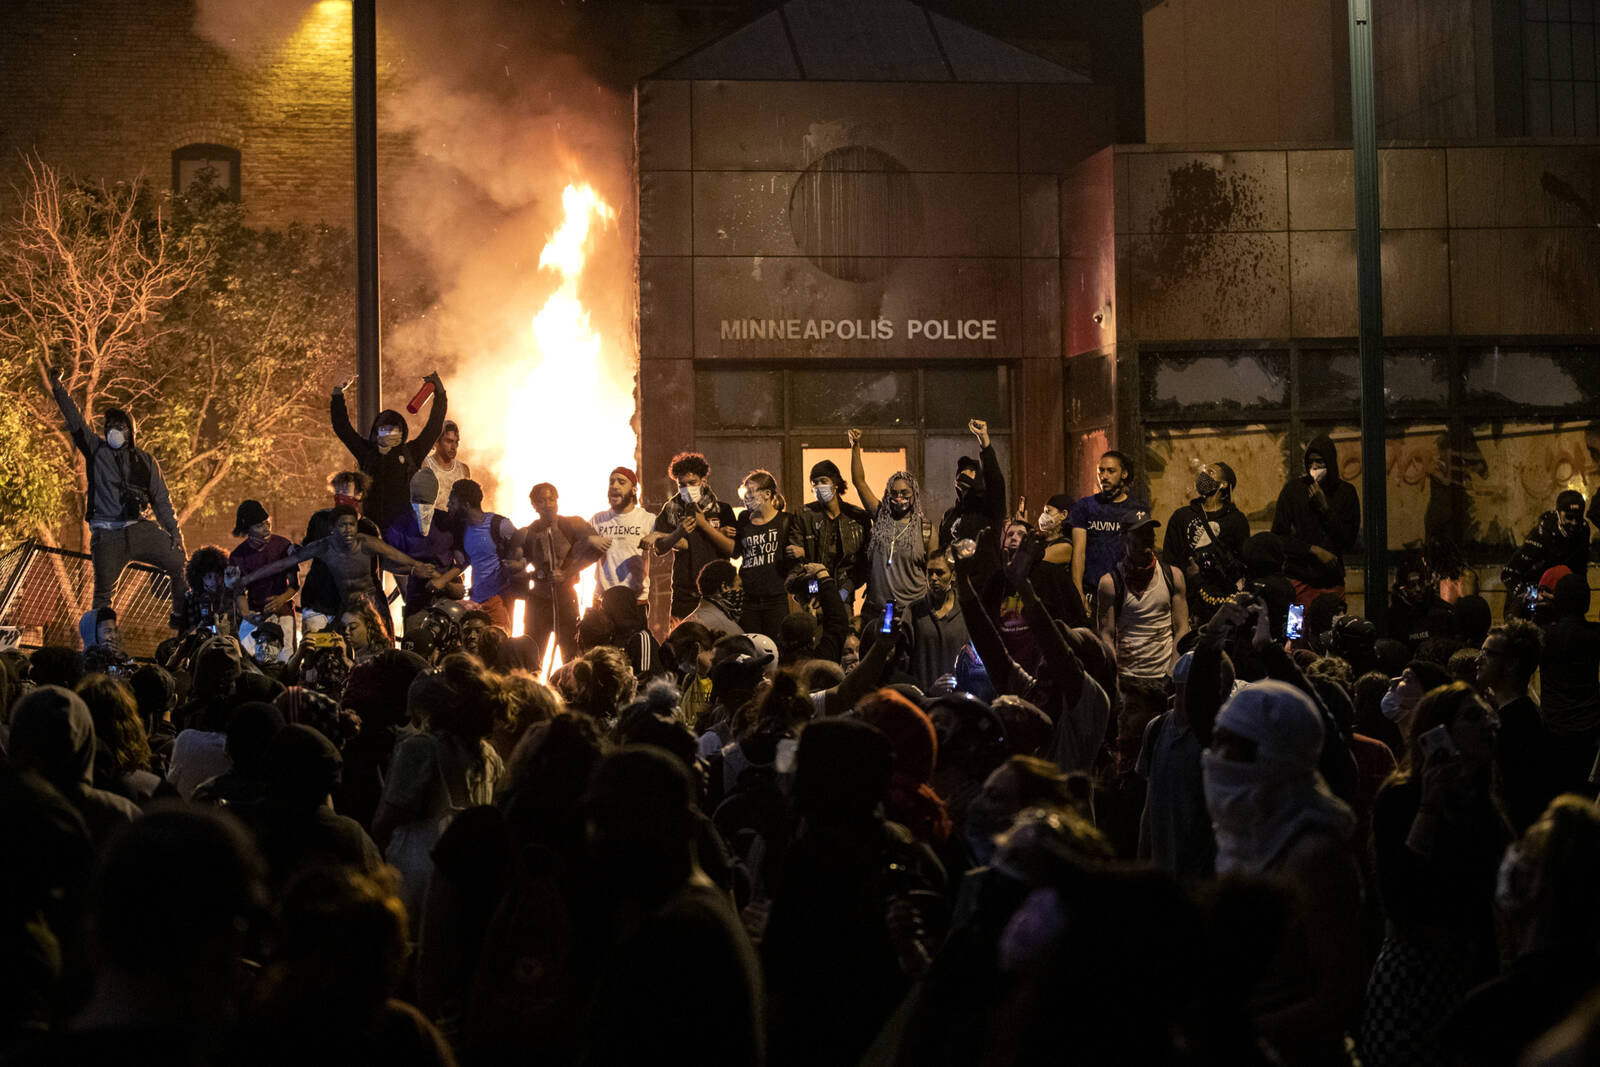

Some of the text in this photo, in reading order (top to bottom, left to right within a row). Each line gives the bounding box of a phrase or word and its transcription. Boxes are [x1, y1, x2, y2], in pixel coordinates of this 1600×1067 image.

[720, 319, 997, 340] MINNEAPOLIS POLICE
[599, 525, 641, 536] PATIENCE
[1087, 520, 1116, 531] CALVIN
[769, 531, 778, 542] IT
[759, 541, 778, 554] YOU
[768, 552, 776, 564] IT
